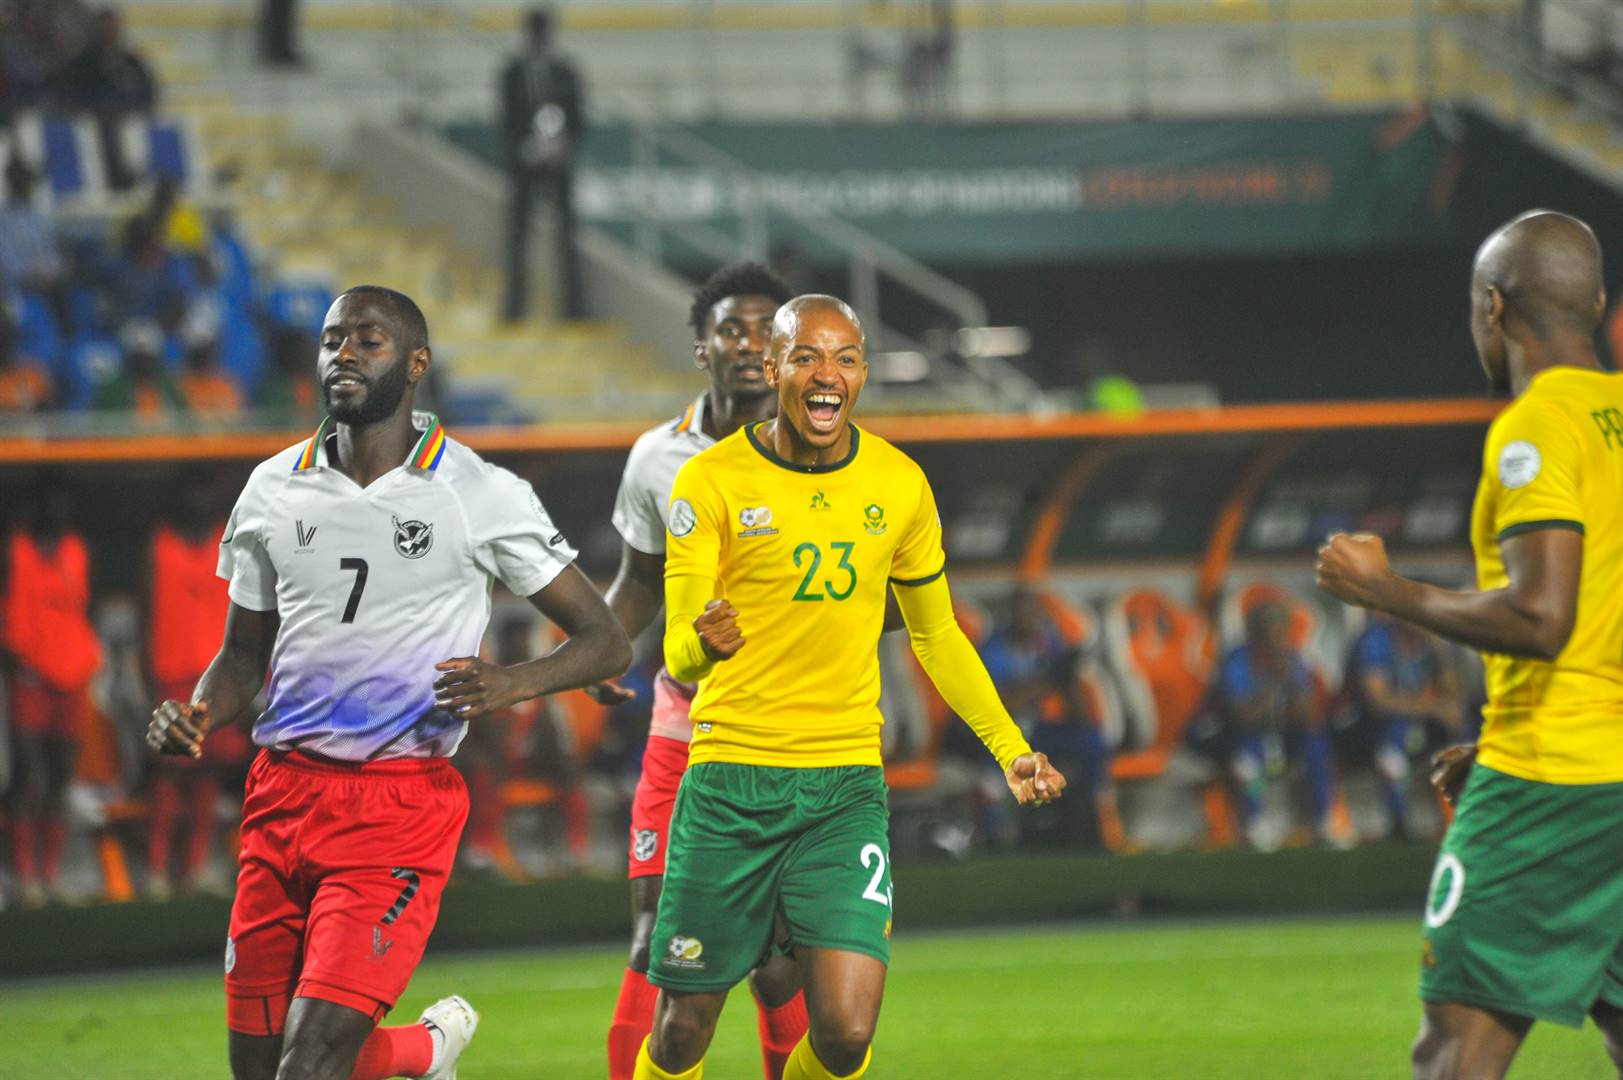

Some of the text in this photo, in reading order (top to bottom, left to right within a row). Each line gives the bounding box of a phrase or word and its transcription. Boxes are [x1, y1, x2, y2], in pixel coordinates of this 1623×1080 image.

[340, 558, 369, 623] 7
[792, 541, 857, 601] 23
[381, 867, 420, 925] 7
[860, 843, 893, 913] 2
